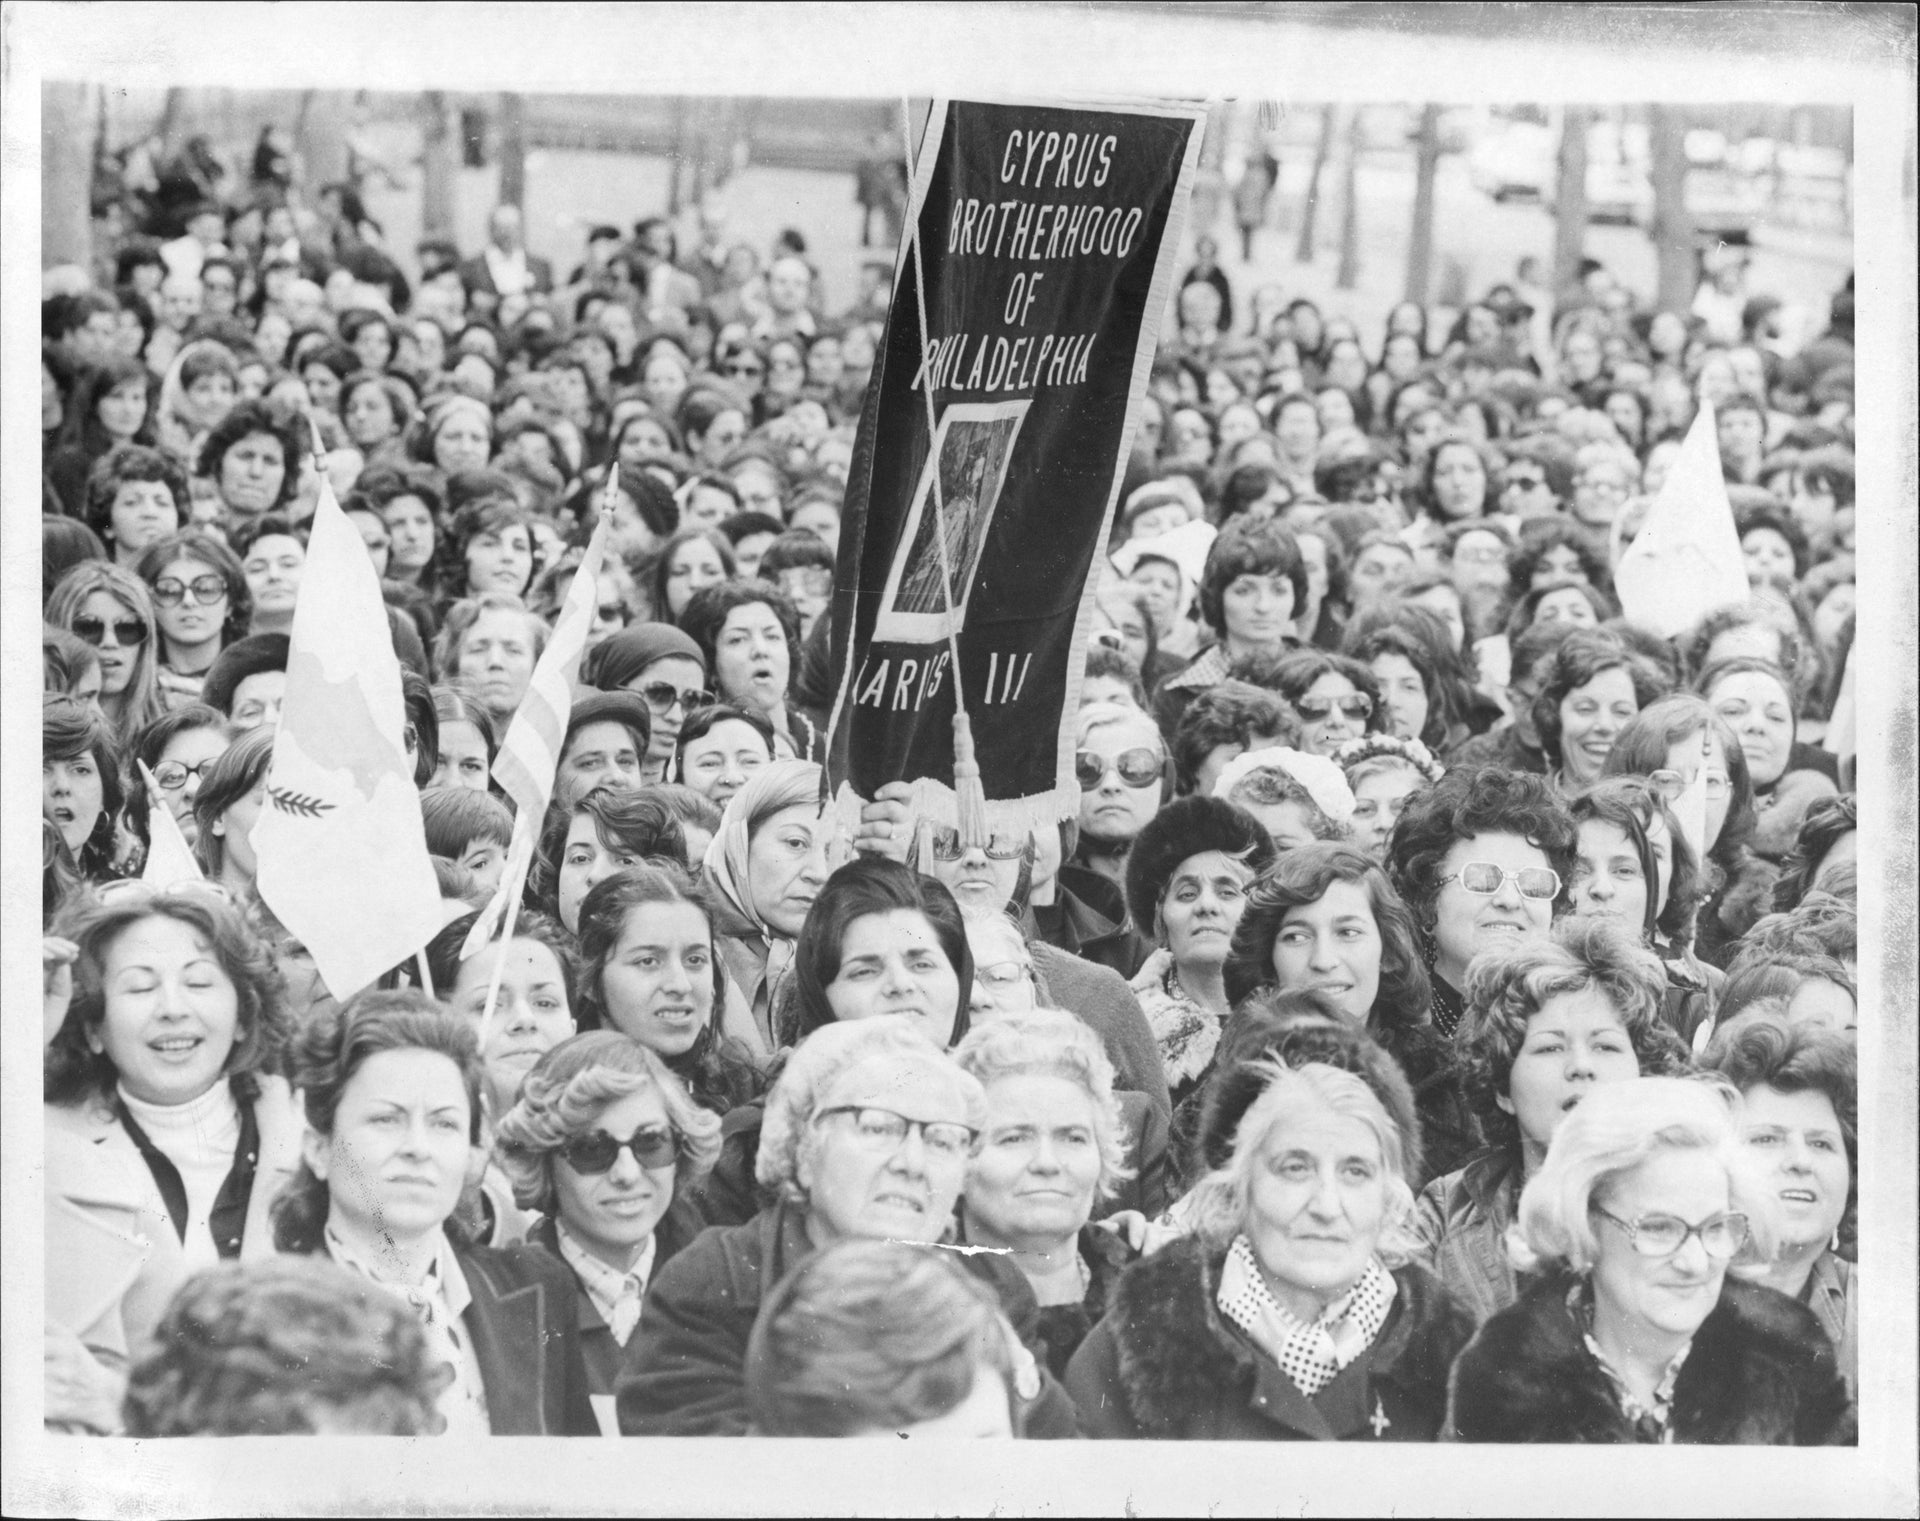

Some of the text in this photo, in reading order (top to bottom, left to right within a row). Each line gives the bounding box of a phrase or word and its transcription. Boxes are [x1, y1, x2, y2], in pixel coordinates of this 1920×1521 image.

[1001, 129, 1118, 188] CYPRUS
[948, 198, 1143, 260] BROTHERHOOD
[1004, 272, 1044, 327] OF
[910, 333, 1097, 392] PHILADELPHIA
[984, 652, 1033, 704] III
